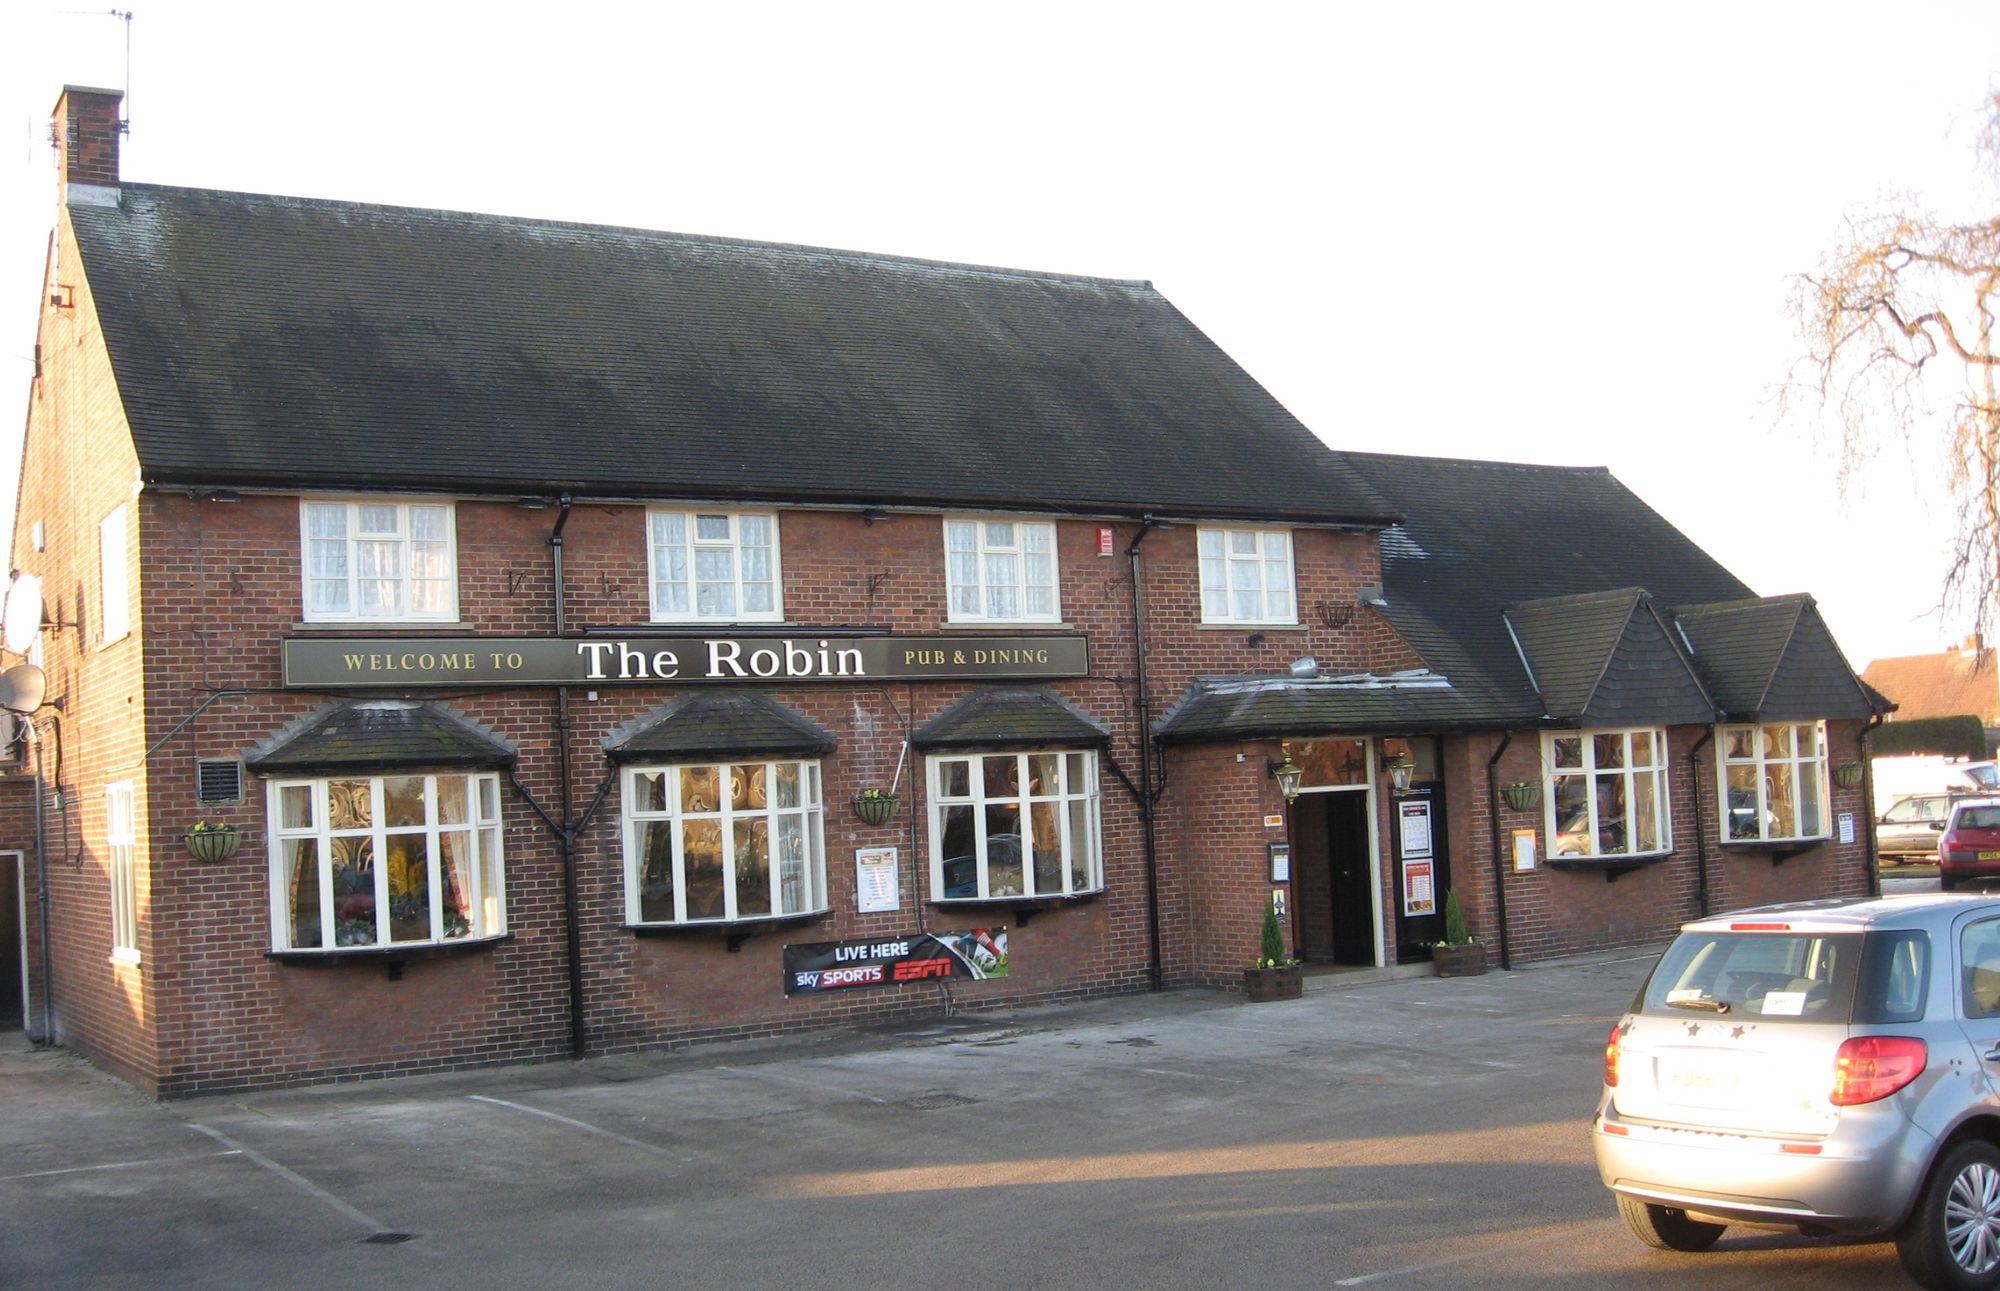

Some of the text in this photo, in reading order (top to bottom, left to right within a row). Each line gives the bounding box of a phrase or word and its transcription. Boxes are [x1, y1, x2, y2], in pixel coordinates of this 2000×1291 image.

[343, 639, 1049, 679] WELCOME TO The Robin PUB & DINING
[835, 941, 909, 961] LIVE HERE
[796, 958, 950, 988] sky SPORTS ESPN
